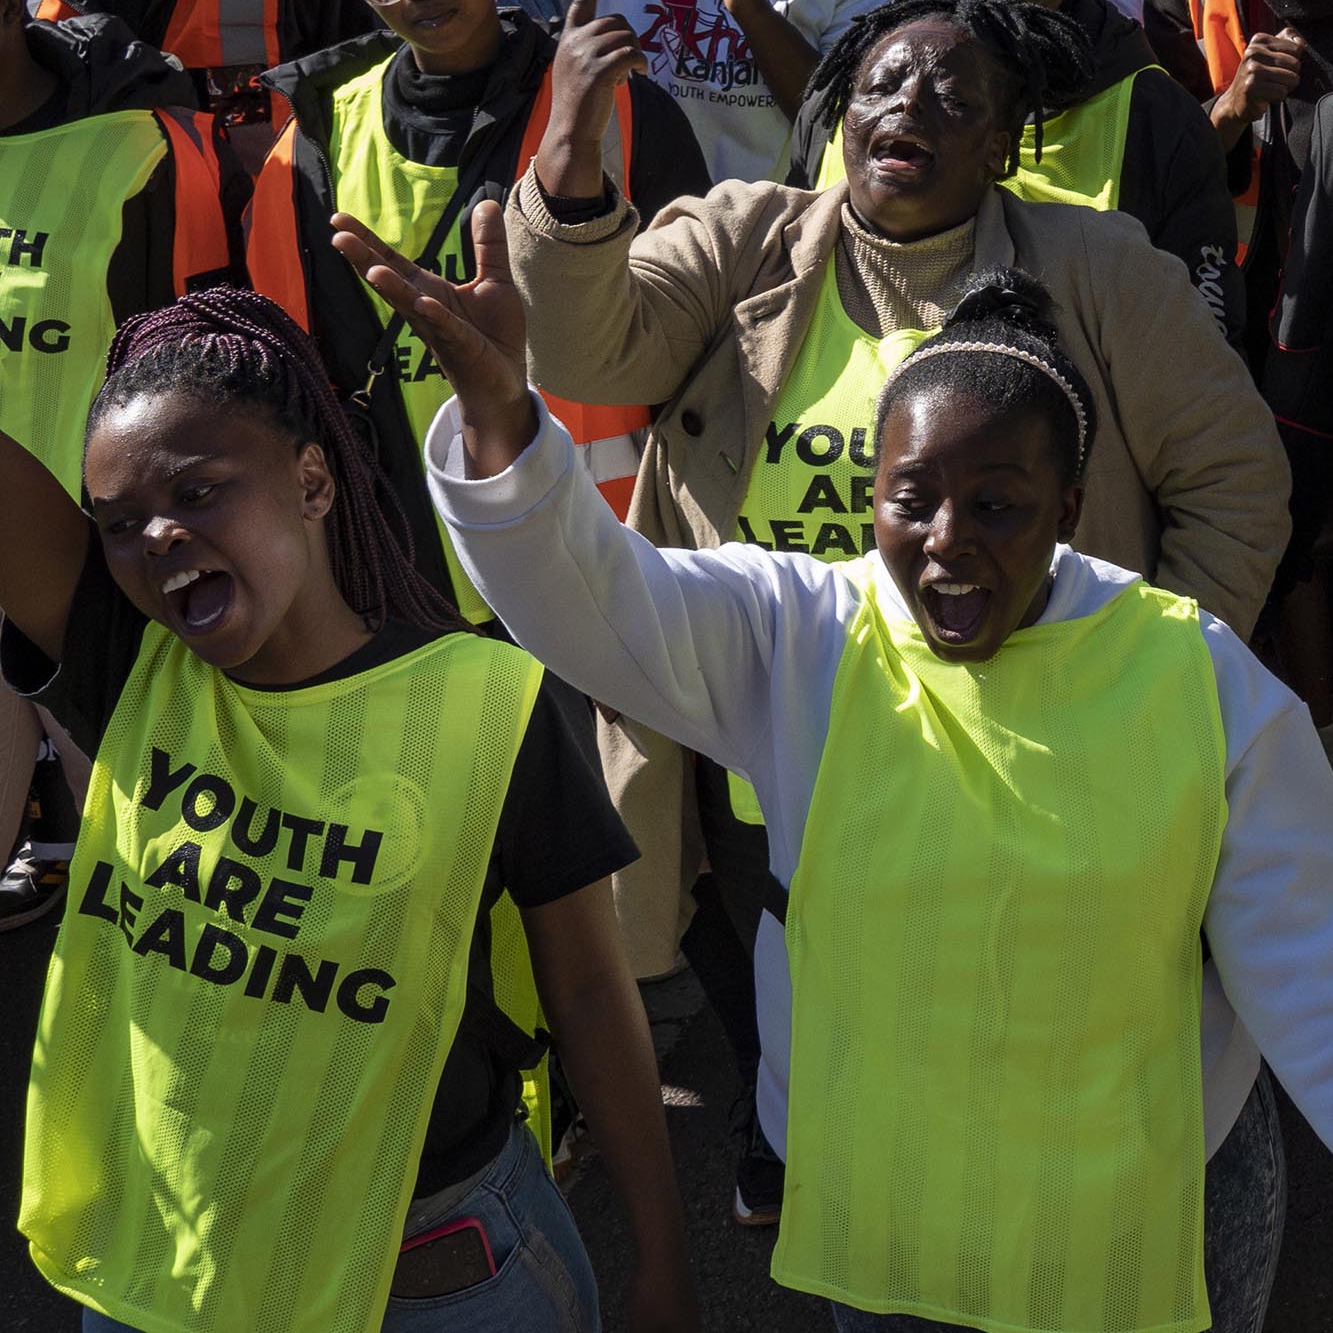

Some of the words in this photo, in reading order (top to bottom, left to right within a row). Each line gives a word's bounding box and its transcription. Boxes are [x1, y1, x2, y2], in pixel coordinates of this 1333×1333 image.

[709, 92, 778, 109] EMPOWER
[765, 420, 877, 467] YOU
[141, 746, 383, 886] YOUTH
[145, 841, 314, 940] ARE
[79, 861, 398, 1024] LEADING
